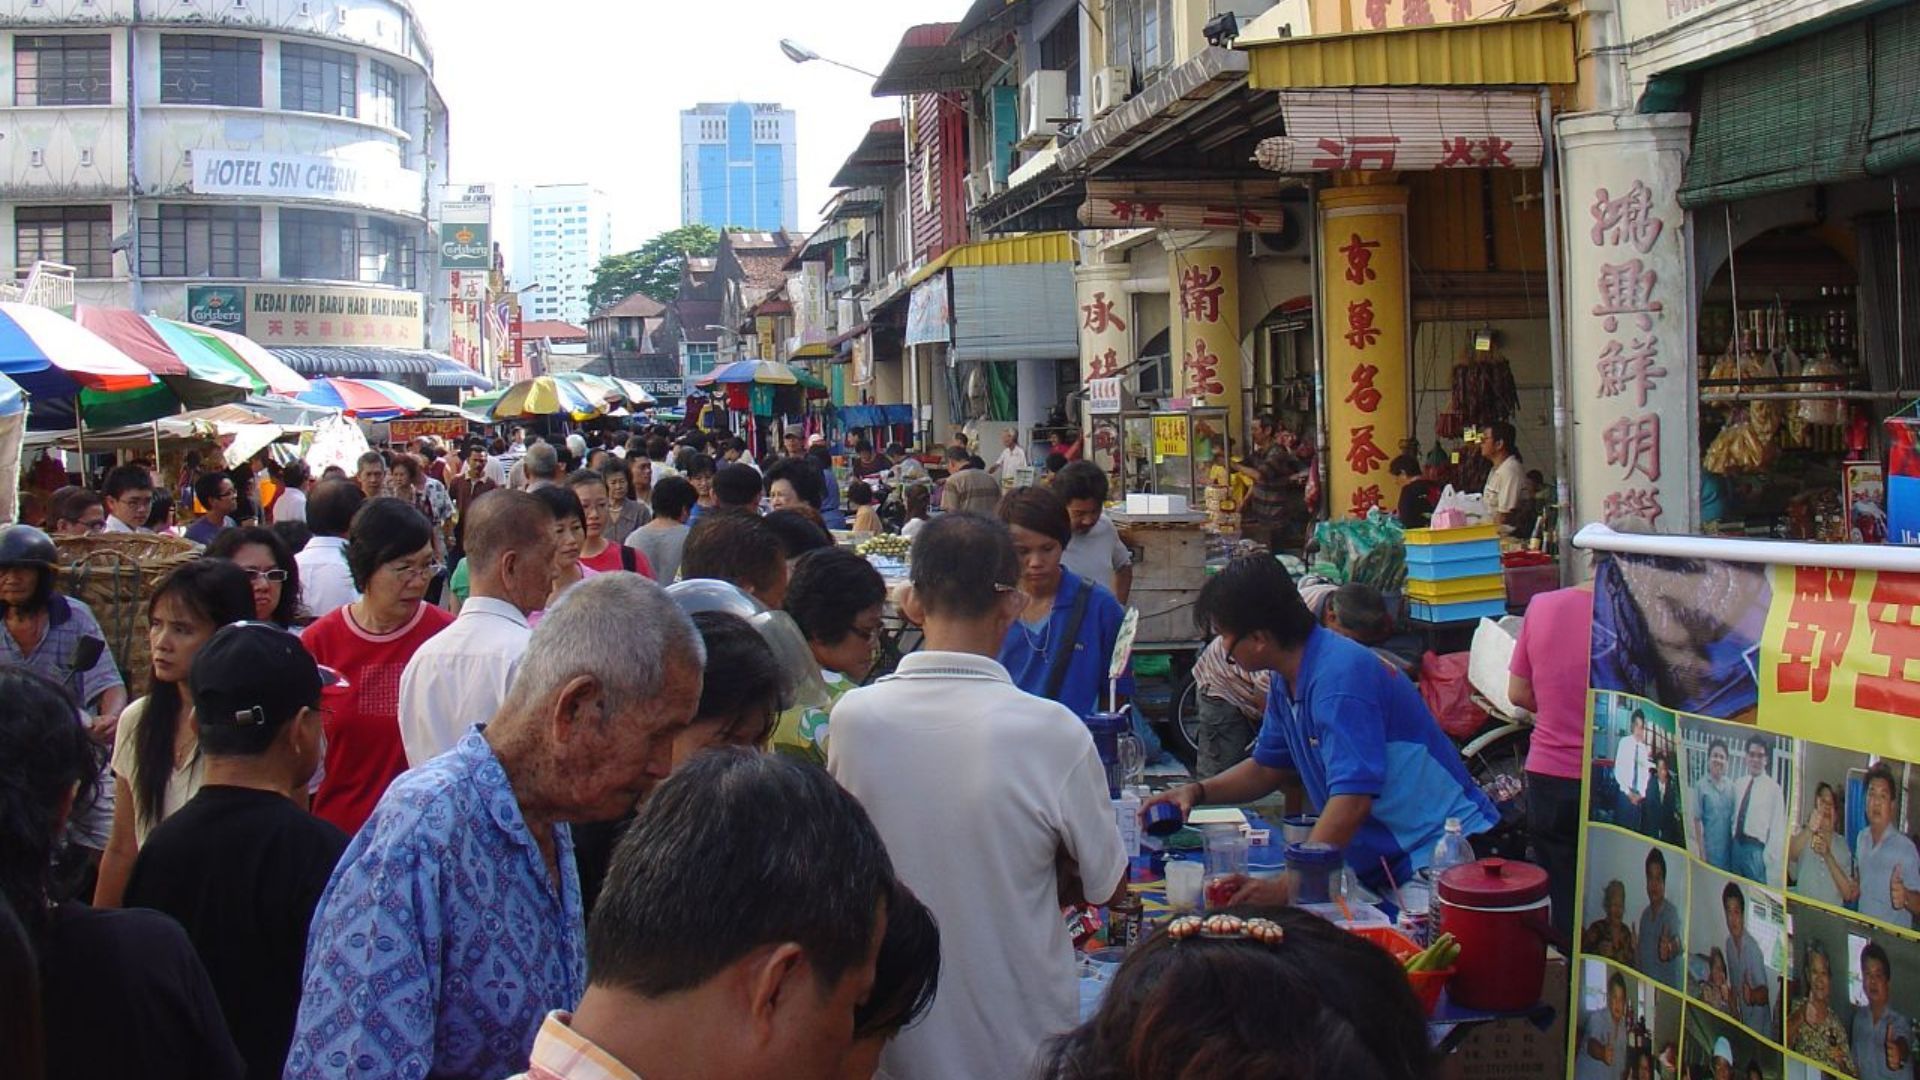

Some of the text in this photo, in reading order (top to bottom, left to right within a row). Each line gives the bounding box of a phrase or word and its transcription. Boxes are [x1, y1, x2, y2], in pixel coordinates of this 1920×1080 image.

[204, 159, 262, 186] HOTEL
[268, 161, 300, 188] SIN
[306, 164, 357, 193] CHERN
[442, 241, 489, 258] Carlsberg
[191, 305, 241, 326] Carlsberg
[254, 293, 418, 318] KEDAI KOPI BARU HARI HARI DATANG
[656, 383, 682, 393] FASHION
